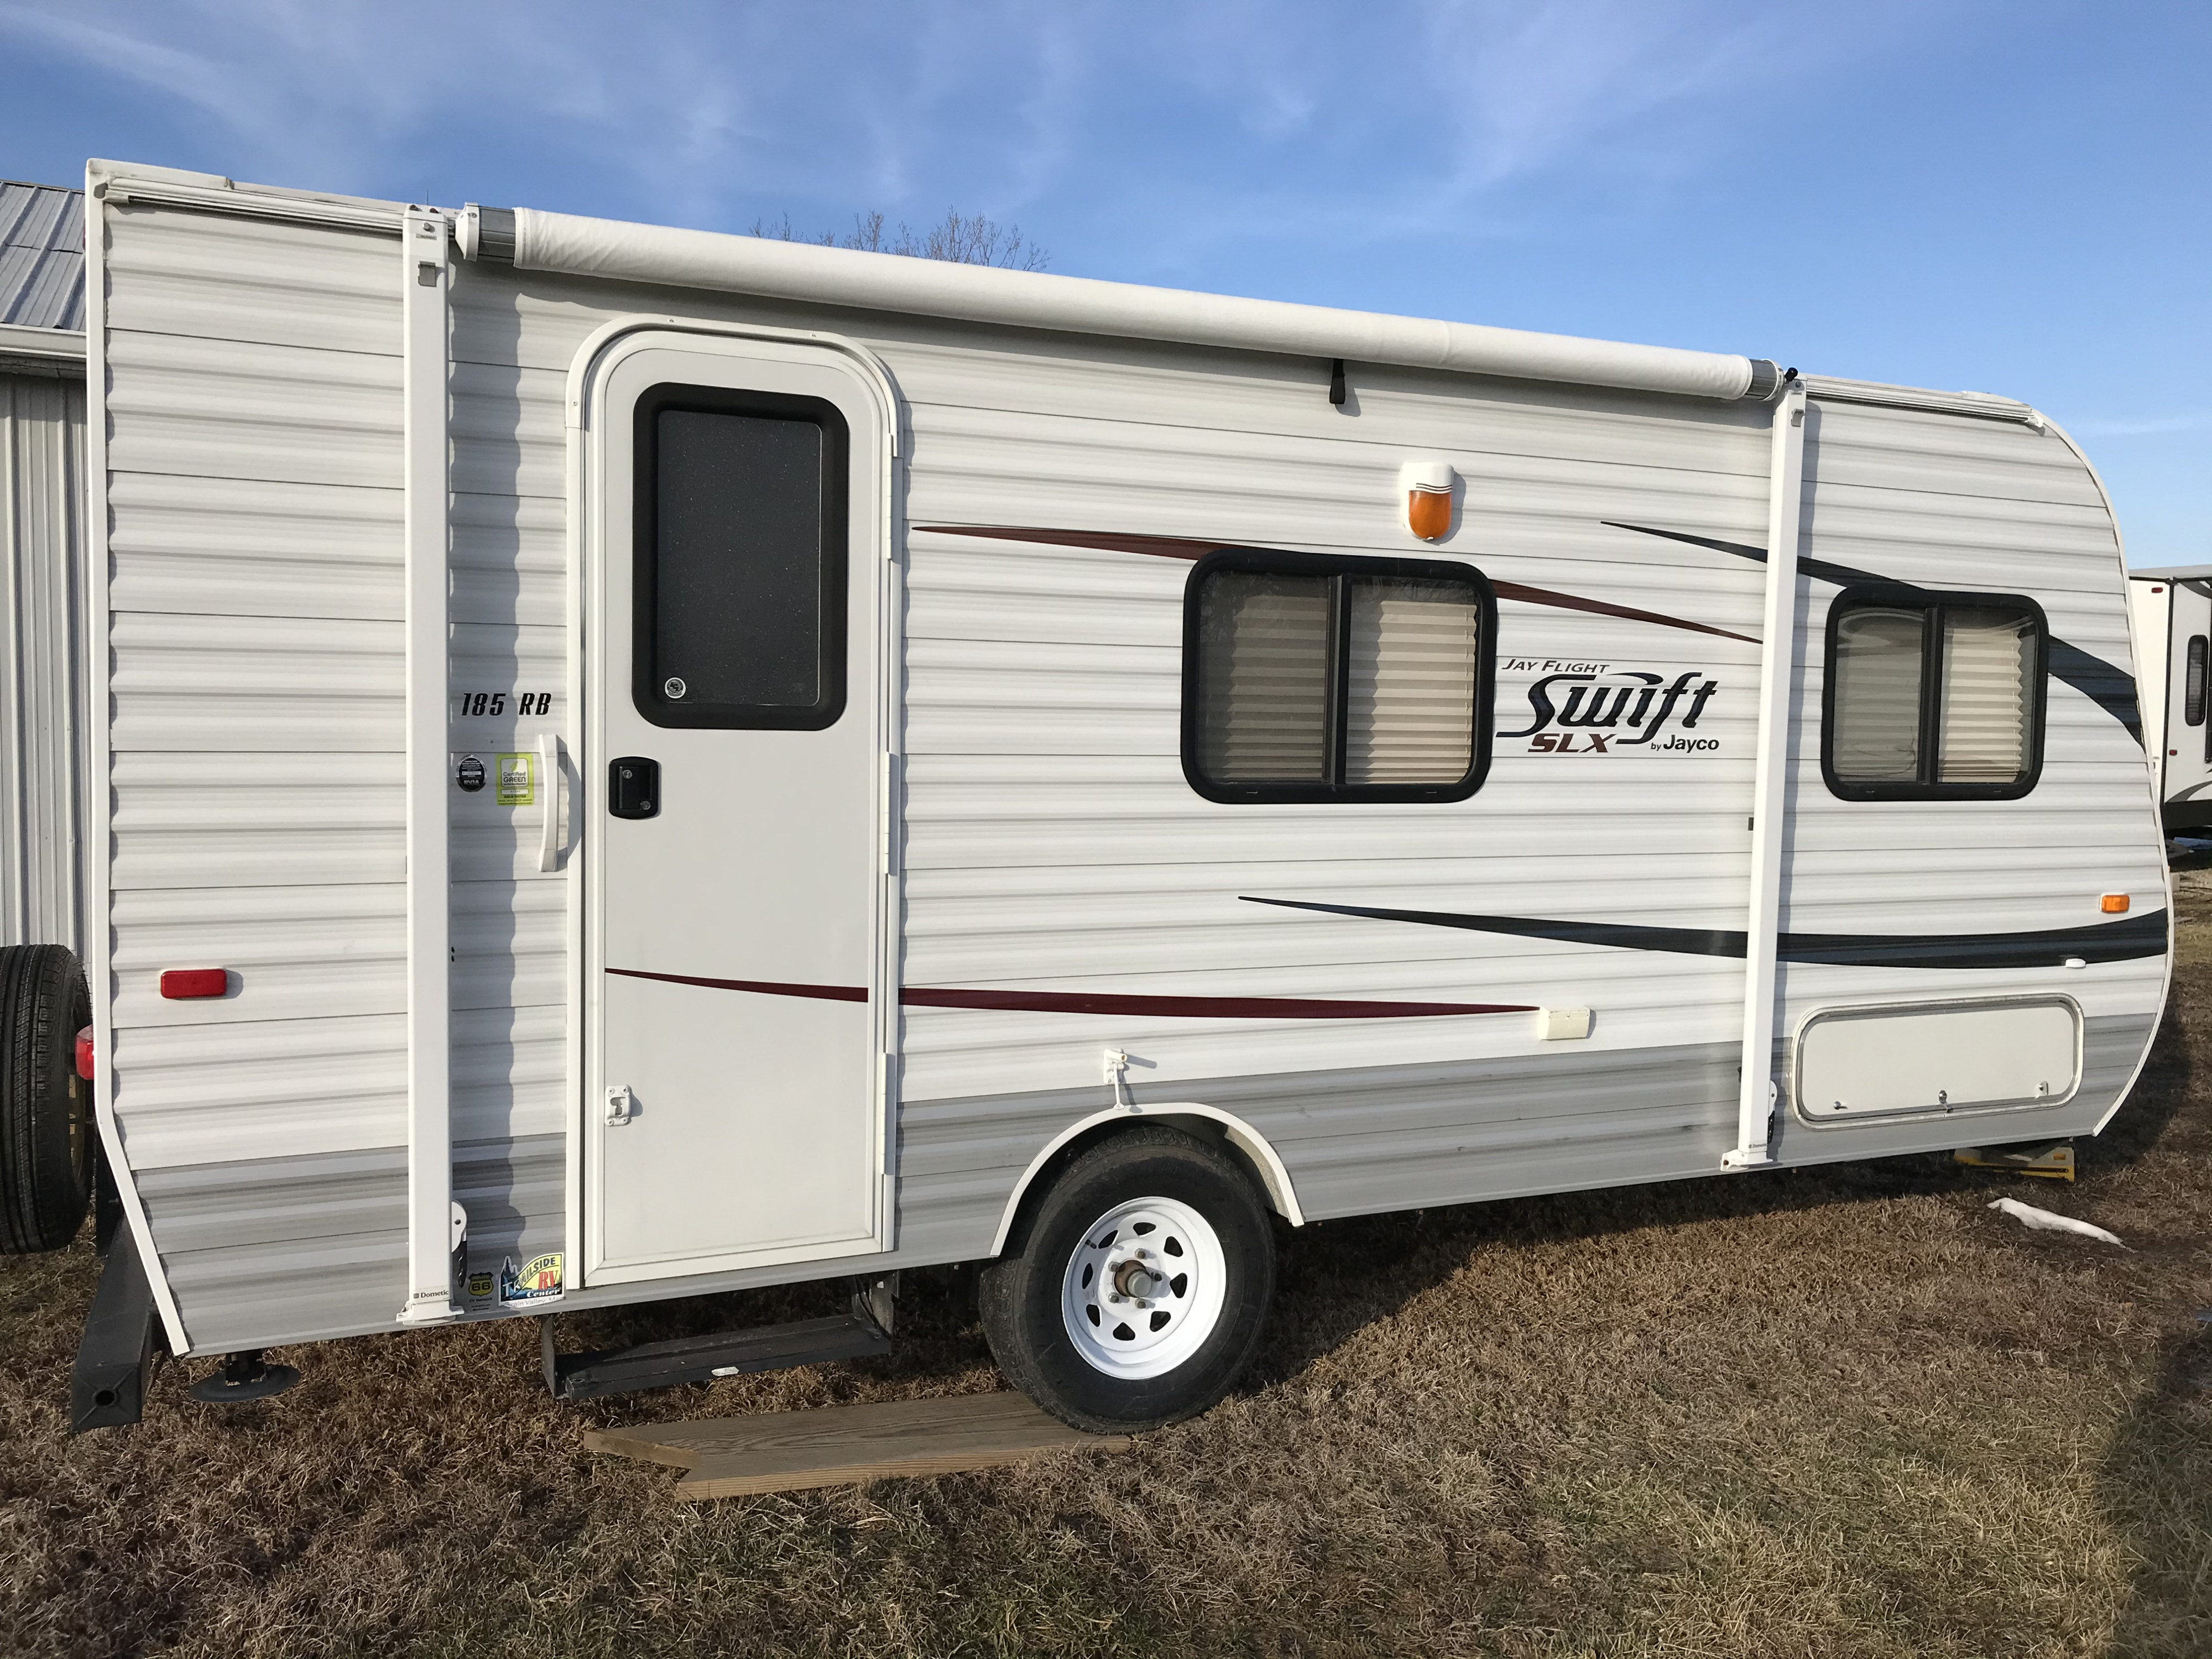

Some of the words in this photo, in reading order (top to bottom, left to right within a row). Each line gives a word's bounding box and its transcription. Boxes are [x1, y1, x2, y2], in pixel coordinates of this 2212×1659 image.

[1502, 658, 1538, 671] JAY
[1541, 660, 1610, 673] FLIGHT
[462, 692, 506, 716] 185
[519, 692, 552, 715] RB
[1495, 672, 1718, 744] Swift
[1527, 733, 1617, 753] SLX
[1651, 742, 1662, 752] by
[1663, 734, 1720, 754] Jayco
[472, 1282, 491, 1291] 66
[502, 1257, 556, 1297] TRAILSIDE
[538, 1270, 559, 1291] RV
[421, 1290, 449, 1298] Dometic
[526, 1289, 560, 1298] Center
